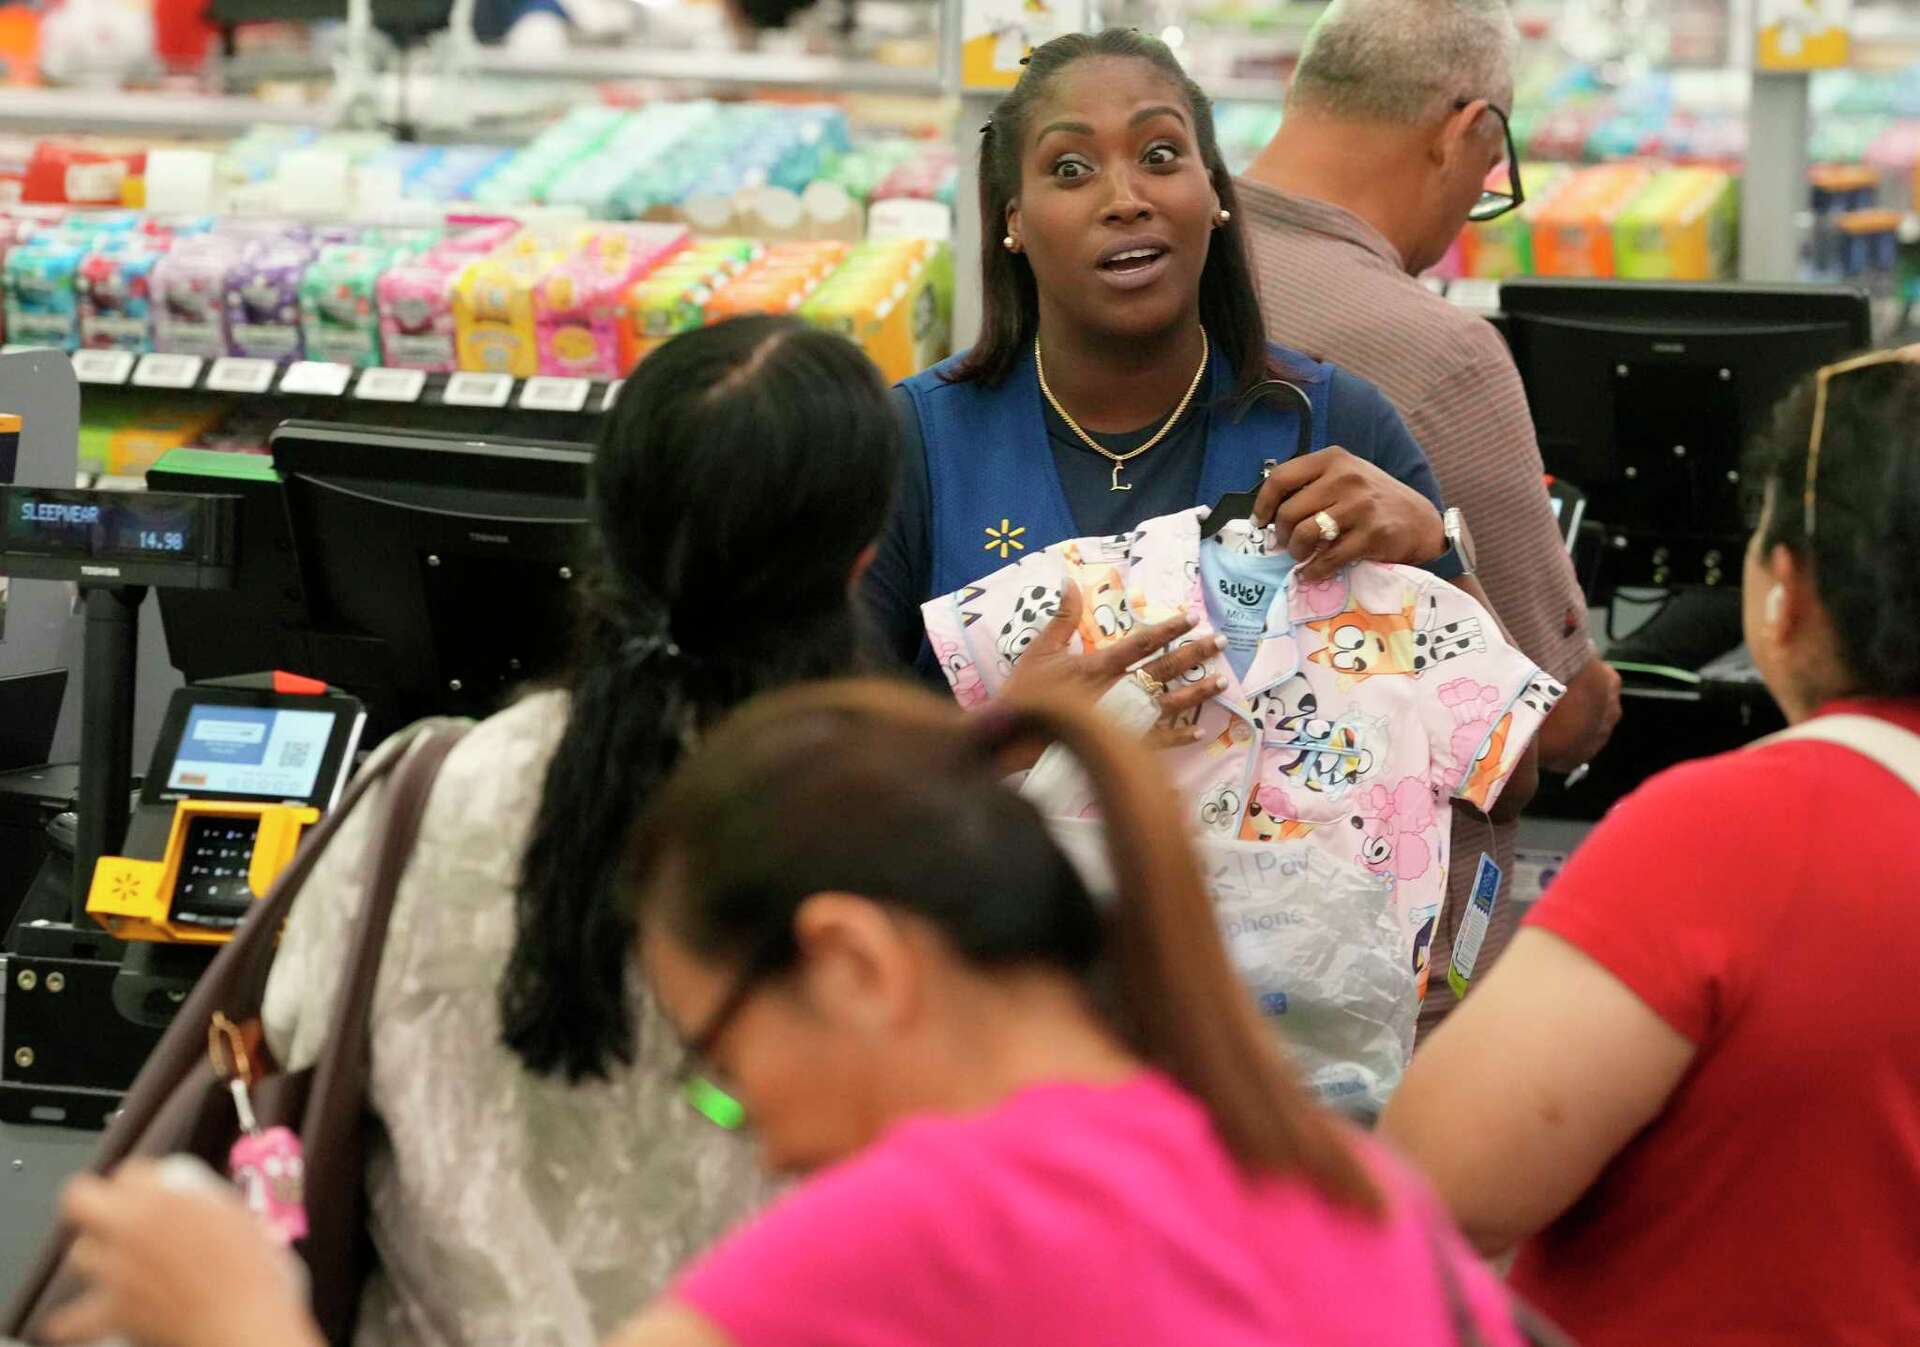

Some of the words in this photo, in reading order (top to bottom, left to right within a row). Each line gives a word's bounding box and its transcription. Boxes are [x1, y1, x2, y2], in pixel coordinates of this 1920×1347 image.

[20, 502, 99, 523] SLEEPWEAR
[139, 531, 184, 550] 14.98
[1219, 579, 1266, 606] BLUEY
